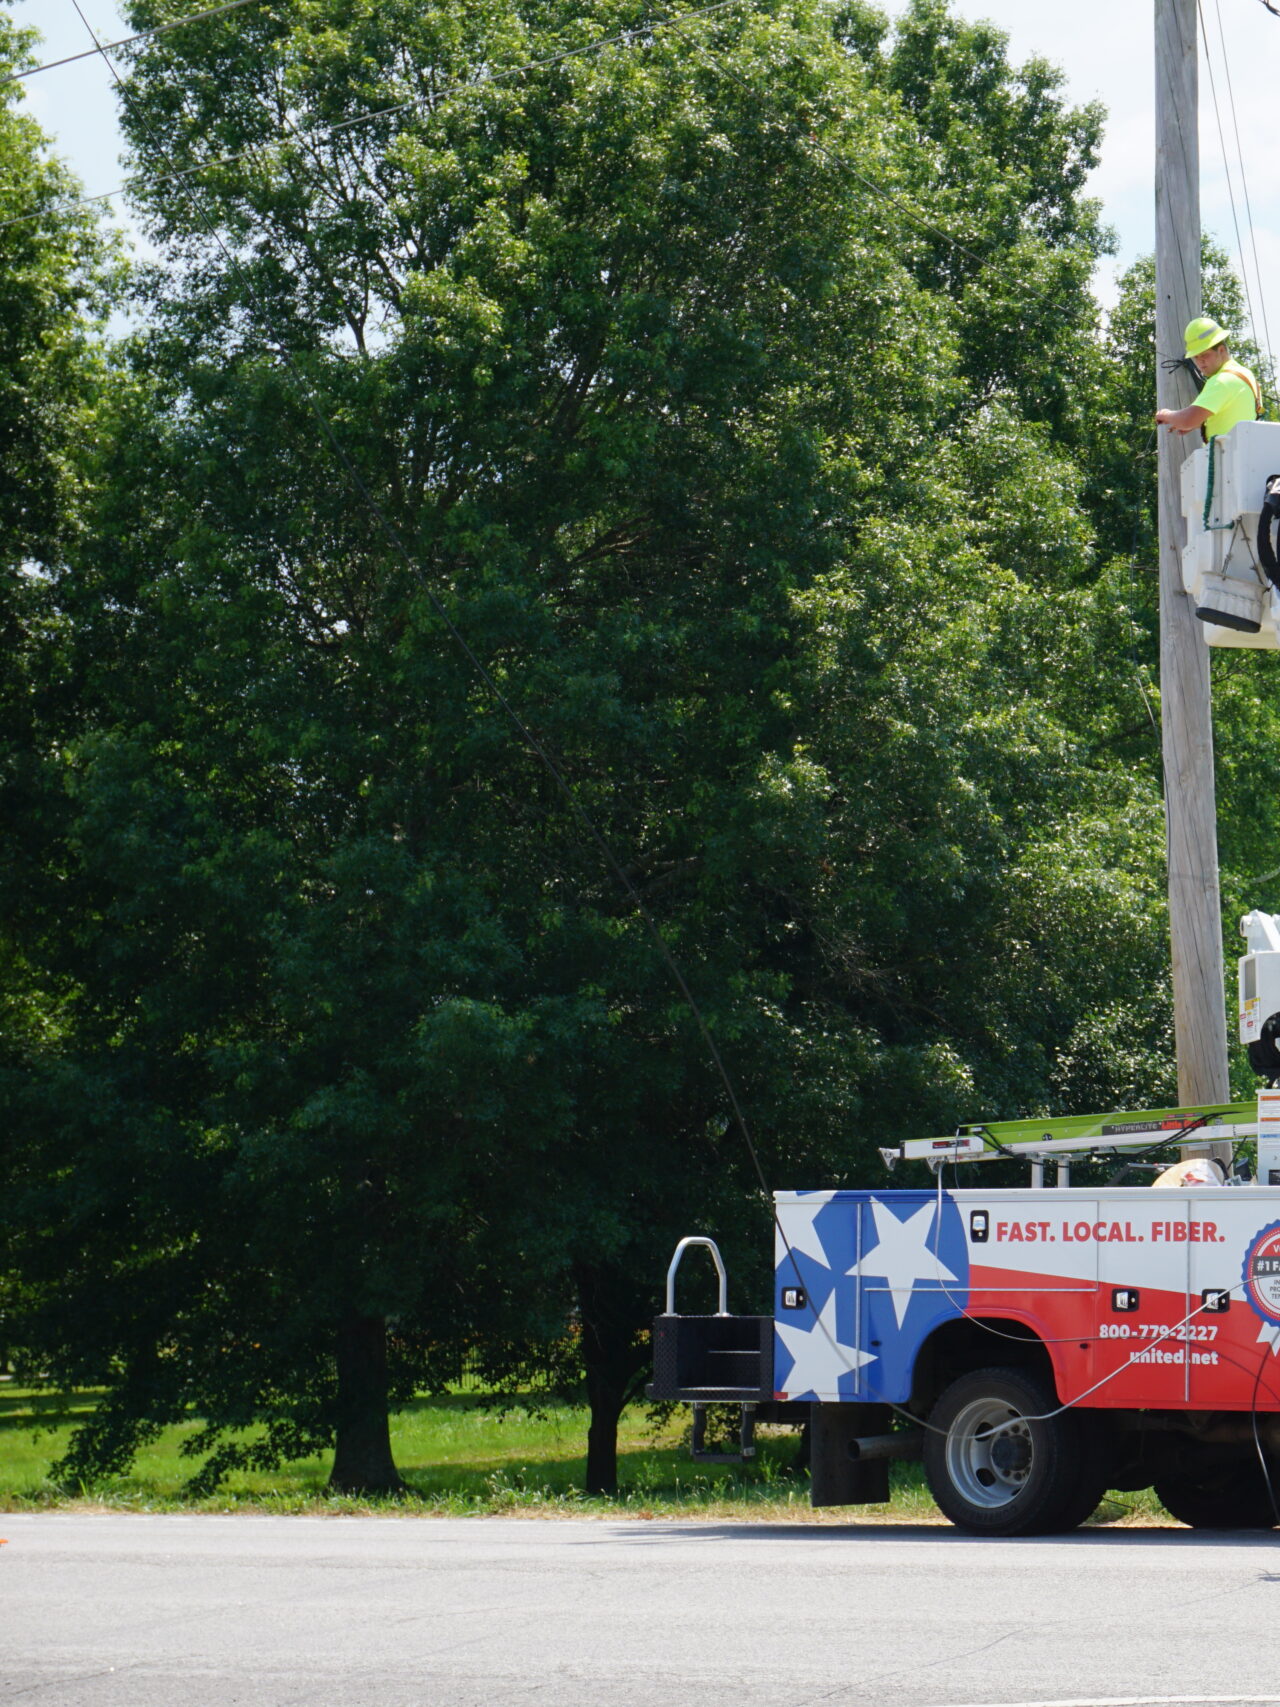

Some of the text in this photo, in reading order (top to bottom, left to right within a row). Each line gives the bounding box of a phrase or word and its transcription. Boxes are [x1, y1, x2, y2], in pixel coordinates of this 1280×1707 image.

[996, 1221, 1226, 1243] FAST. LOCAL. FIBER.
[1257, 1260, 1270, 1271] #1
[1100, 1324, 1219, 1341] 800-779-2227
[1130, 1348, 1219, 1365] united.net
